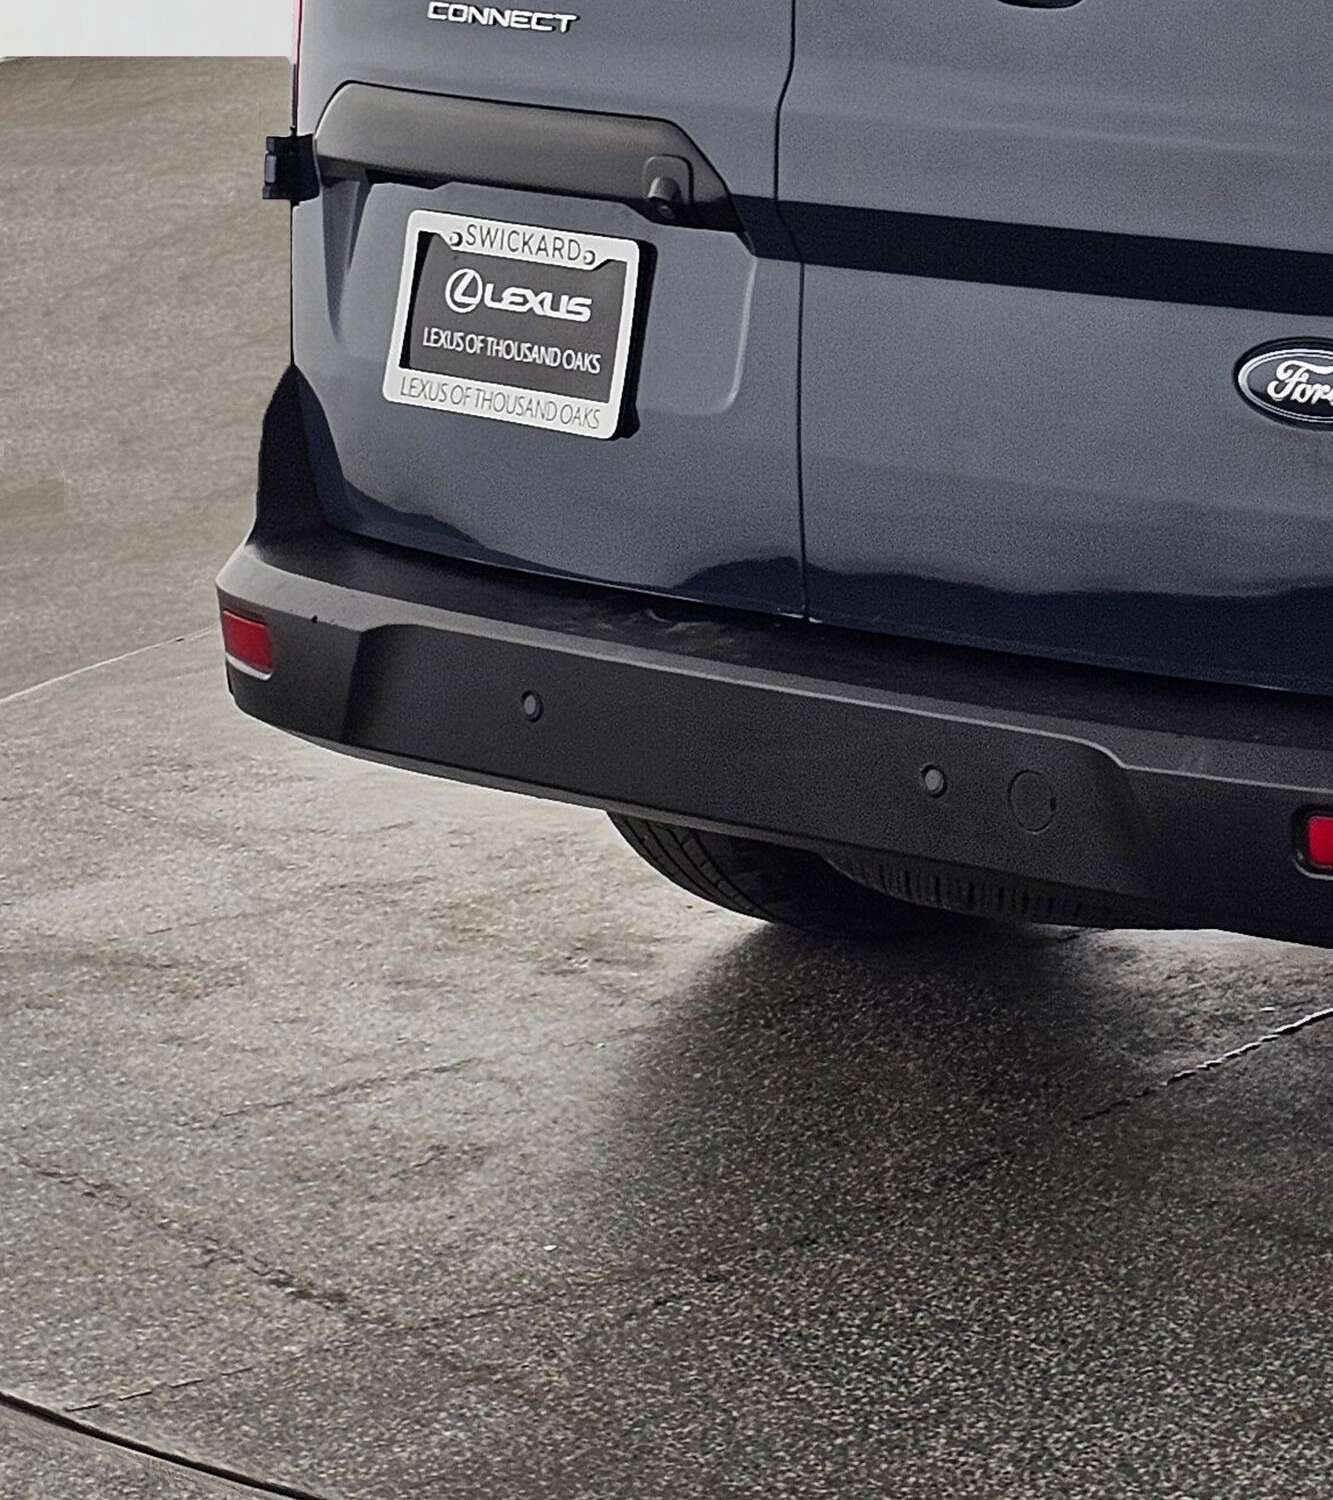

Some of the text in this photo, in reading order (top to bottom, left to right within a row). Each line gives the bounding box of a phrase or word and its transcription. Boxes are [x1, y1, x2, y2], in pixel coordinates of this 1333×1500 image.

[427, 0, 579, 33] CONNECT
[466, 223, 582, 262] SWICKARD
[483, 283, 593, 322] LEXUS
[422, 327, 602, 375] LEXUS OF THOUSAND OAKS
[400, 376, 602, 430] LEXUS OF THOUSAND OAKS
